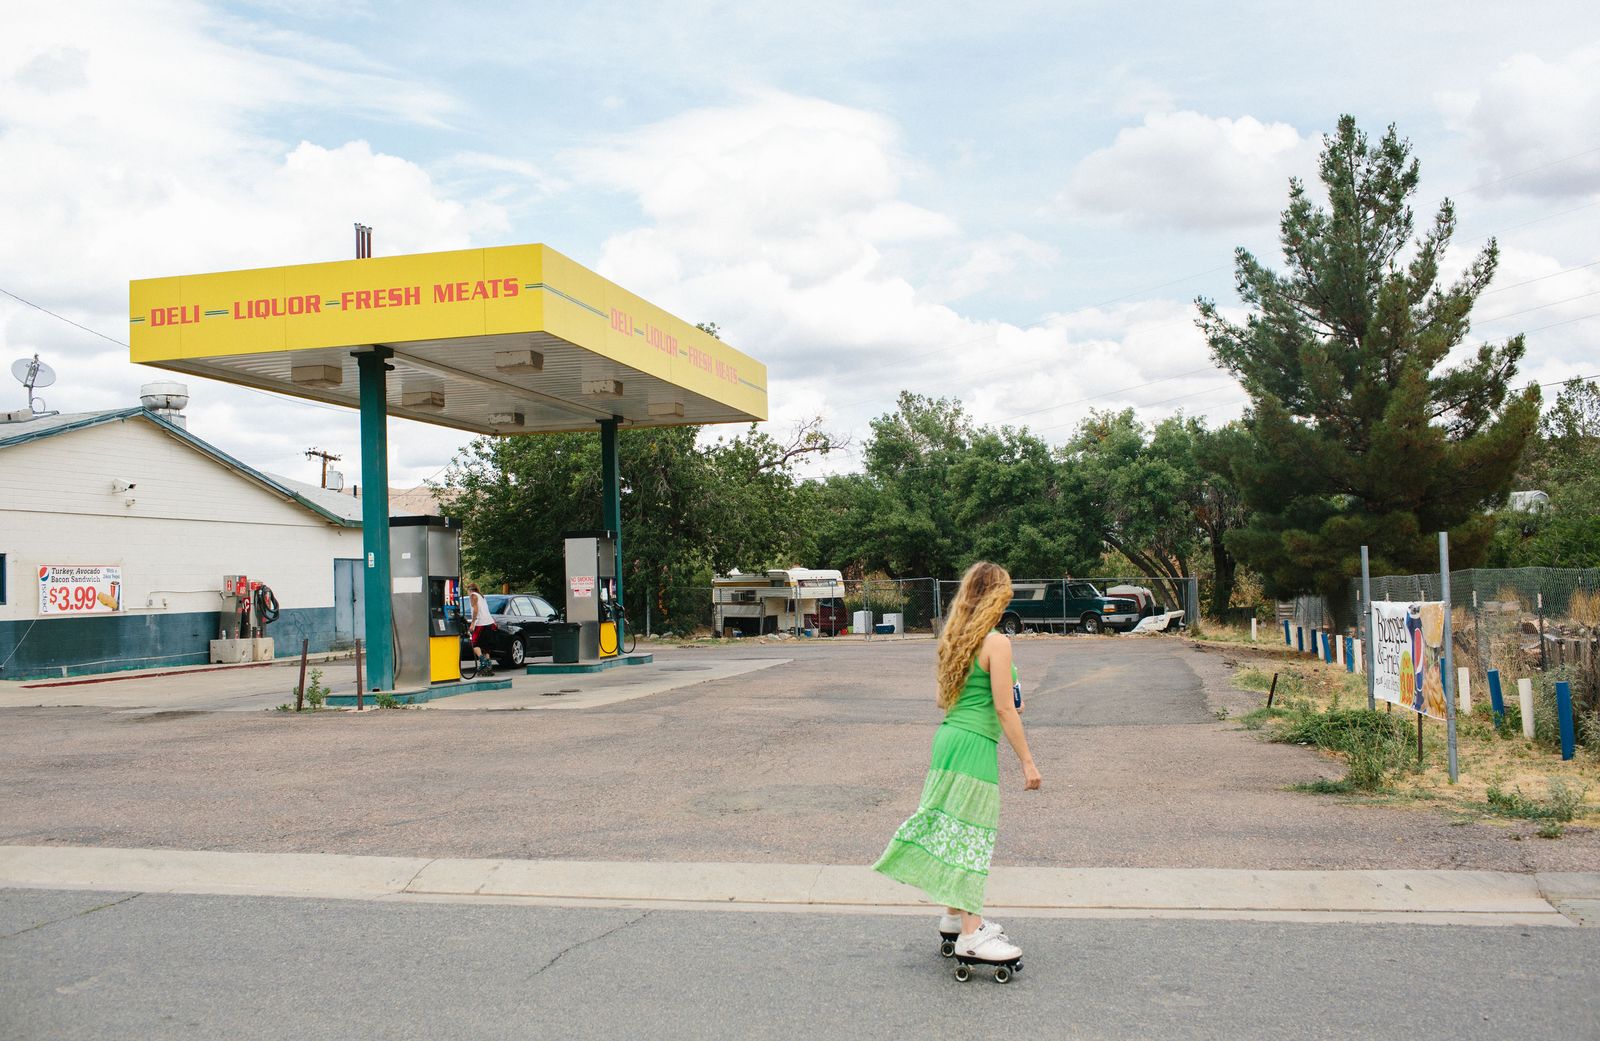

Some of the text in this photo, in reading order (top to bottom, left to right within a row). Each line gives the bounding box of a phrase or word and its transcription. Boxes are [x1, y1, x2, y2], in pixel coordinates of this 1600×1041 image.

[150, 277, 519, 327] DELI LIQUOR FRESH MEATS
[610, 307, 738, 385] DELI LIQUOR FRESH MEATS
[71, 575, 101, 583] Sandwich
[75, 567, 101, 575] Avocado
[49, 586, 97, 611] $3.99
[1375, 607, 1407, 654] Burger
